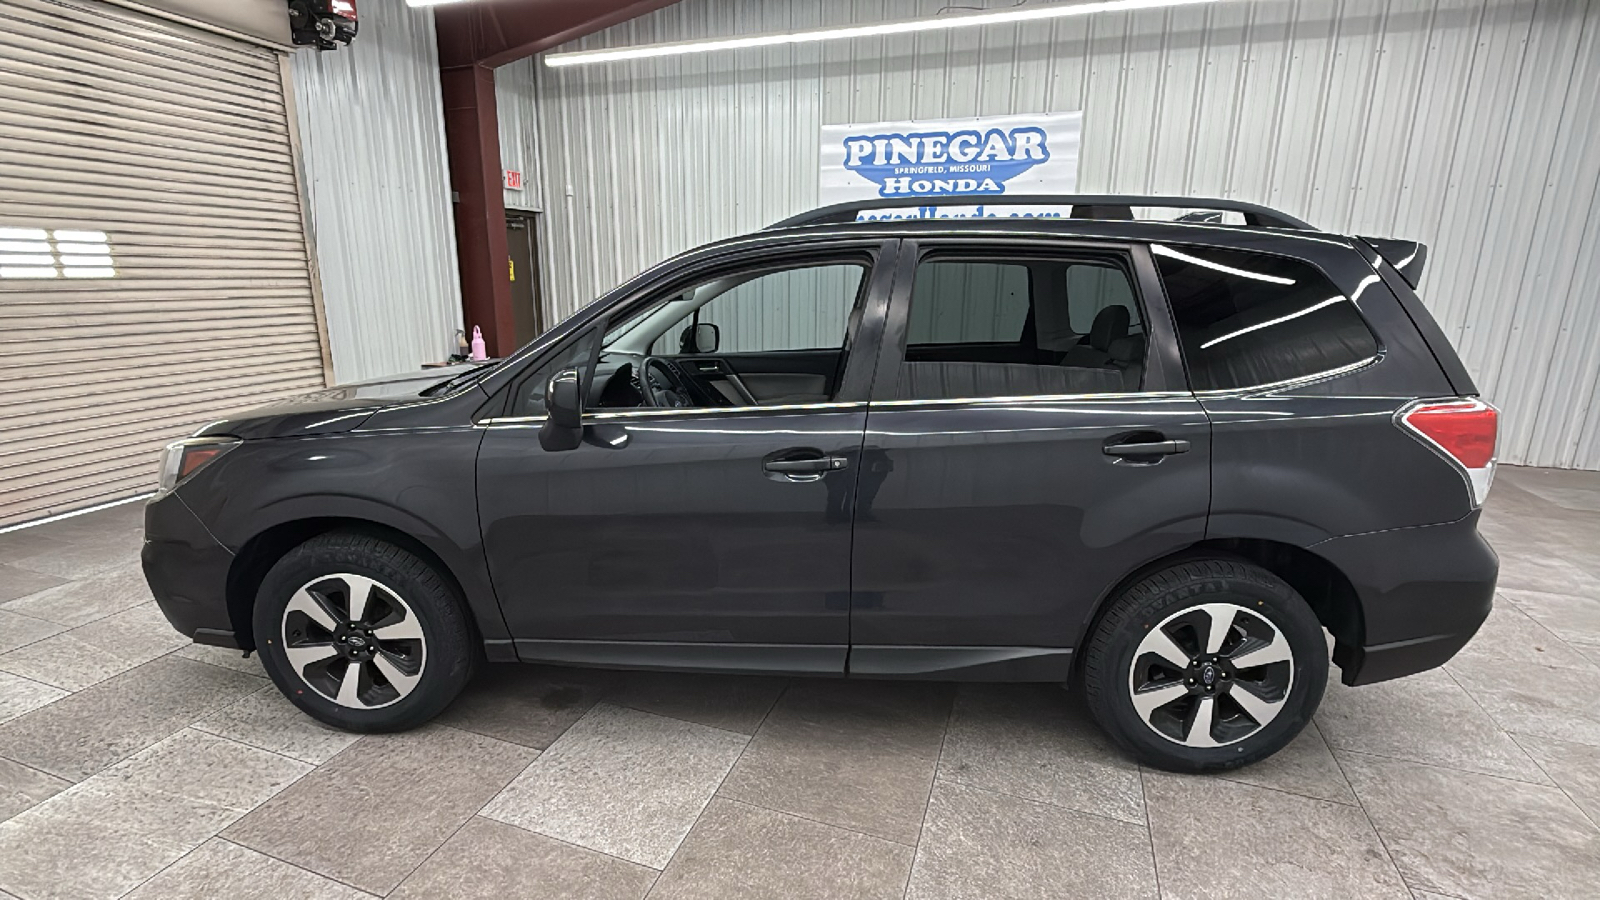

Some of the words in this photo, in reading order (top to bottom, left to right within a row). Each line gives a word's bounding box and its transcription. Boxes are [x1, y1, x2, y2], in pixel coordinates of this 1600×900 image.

[846, 131, 1047, 167] PINEGAR
[894, 165, 948, 175] SPRINGFIELD,
[949, 164, 992, 173] MISSOURI
[506, 170, 521, 188] EXIT
